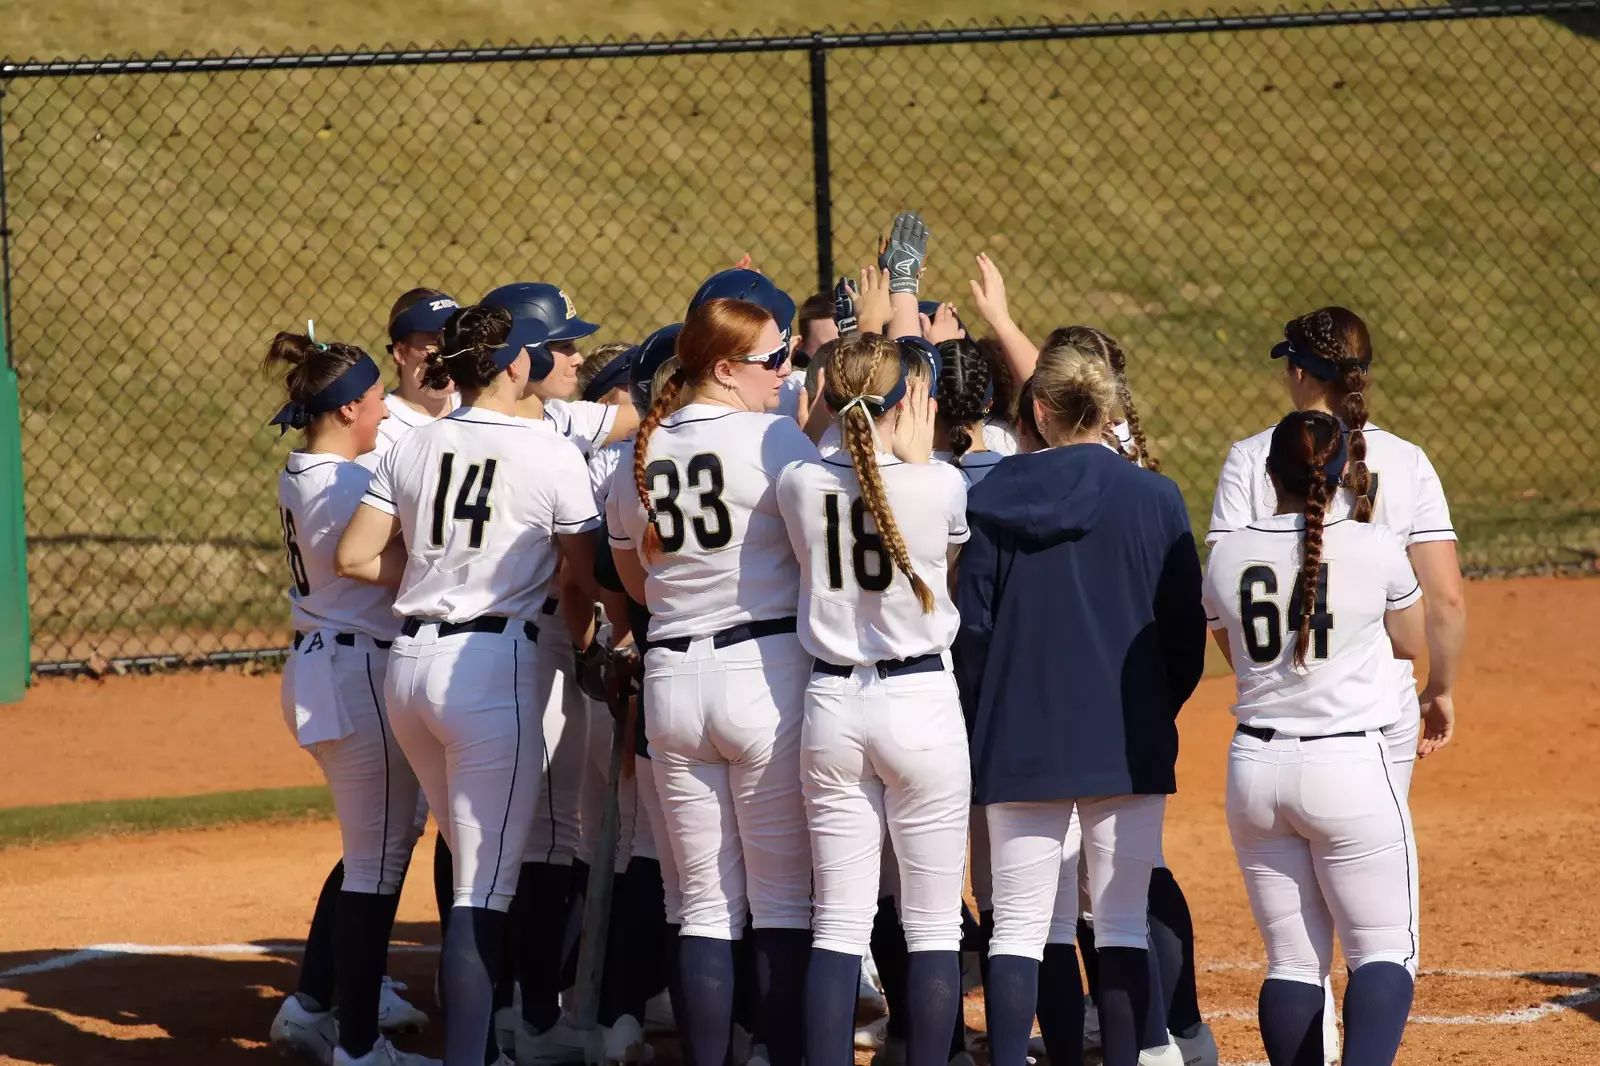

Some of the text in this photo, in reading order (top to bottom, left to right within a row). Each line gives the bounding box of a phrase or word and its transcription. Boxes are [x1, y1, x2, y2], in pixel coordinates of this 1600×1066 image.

[432, 452, 498, 550] 14
[645, 452, 734, 554] 33
[823, 491, 895, 592] 18
[304, 631, 325, 655] A
[1238, 562, 1335, 664] 64
